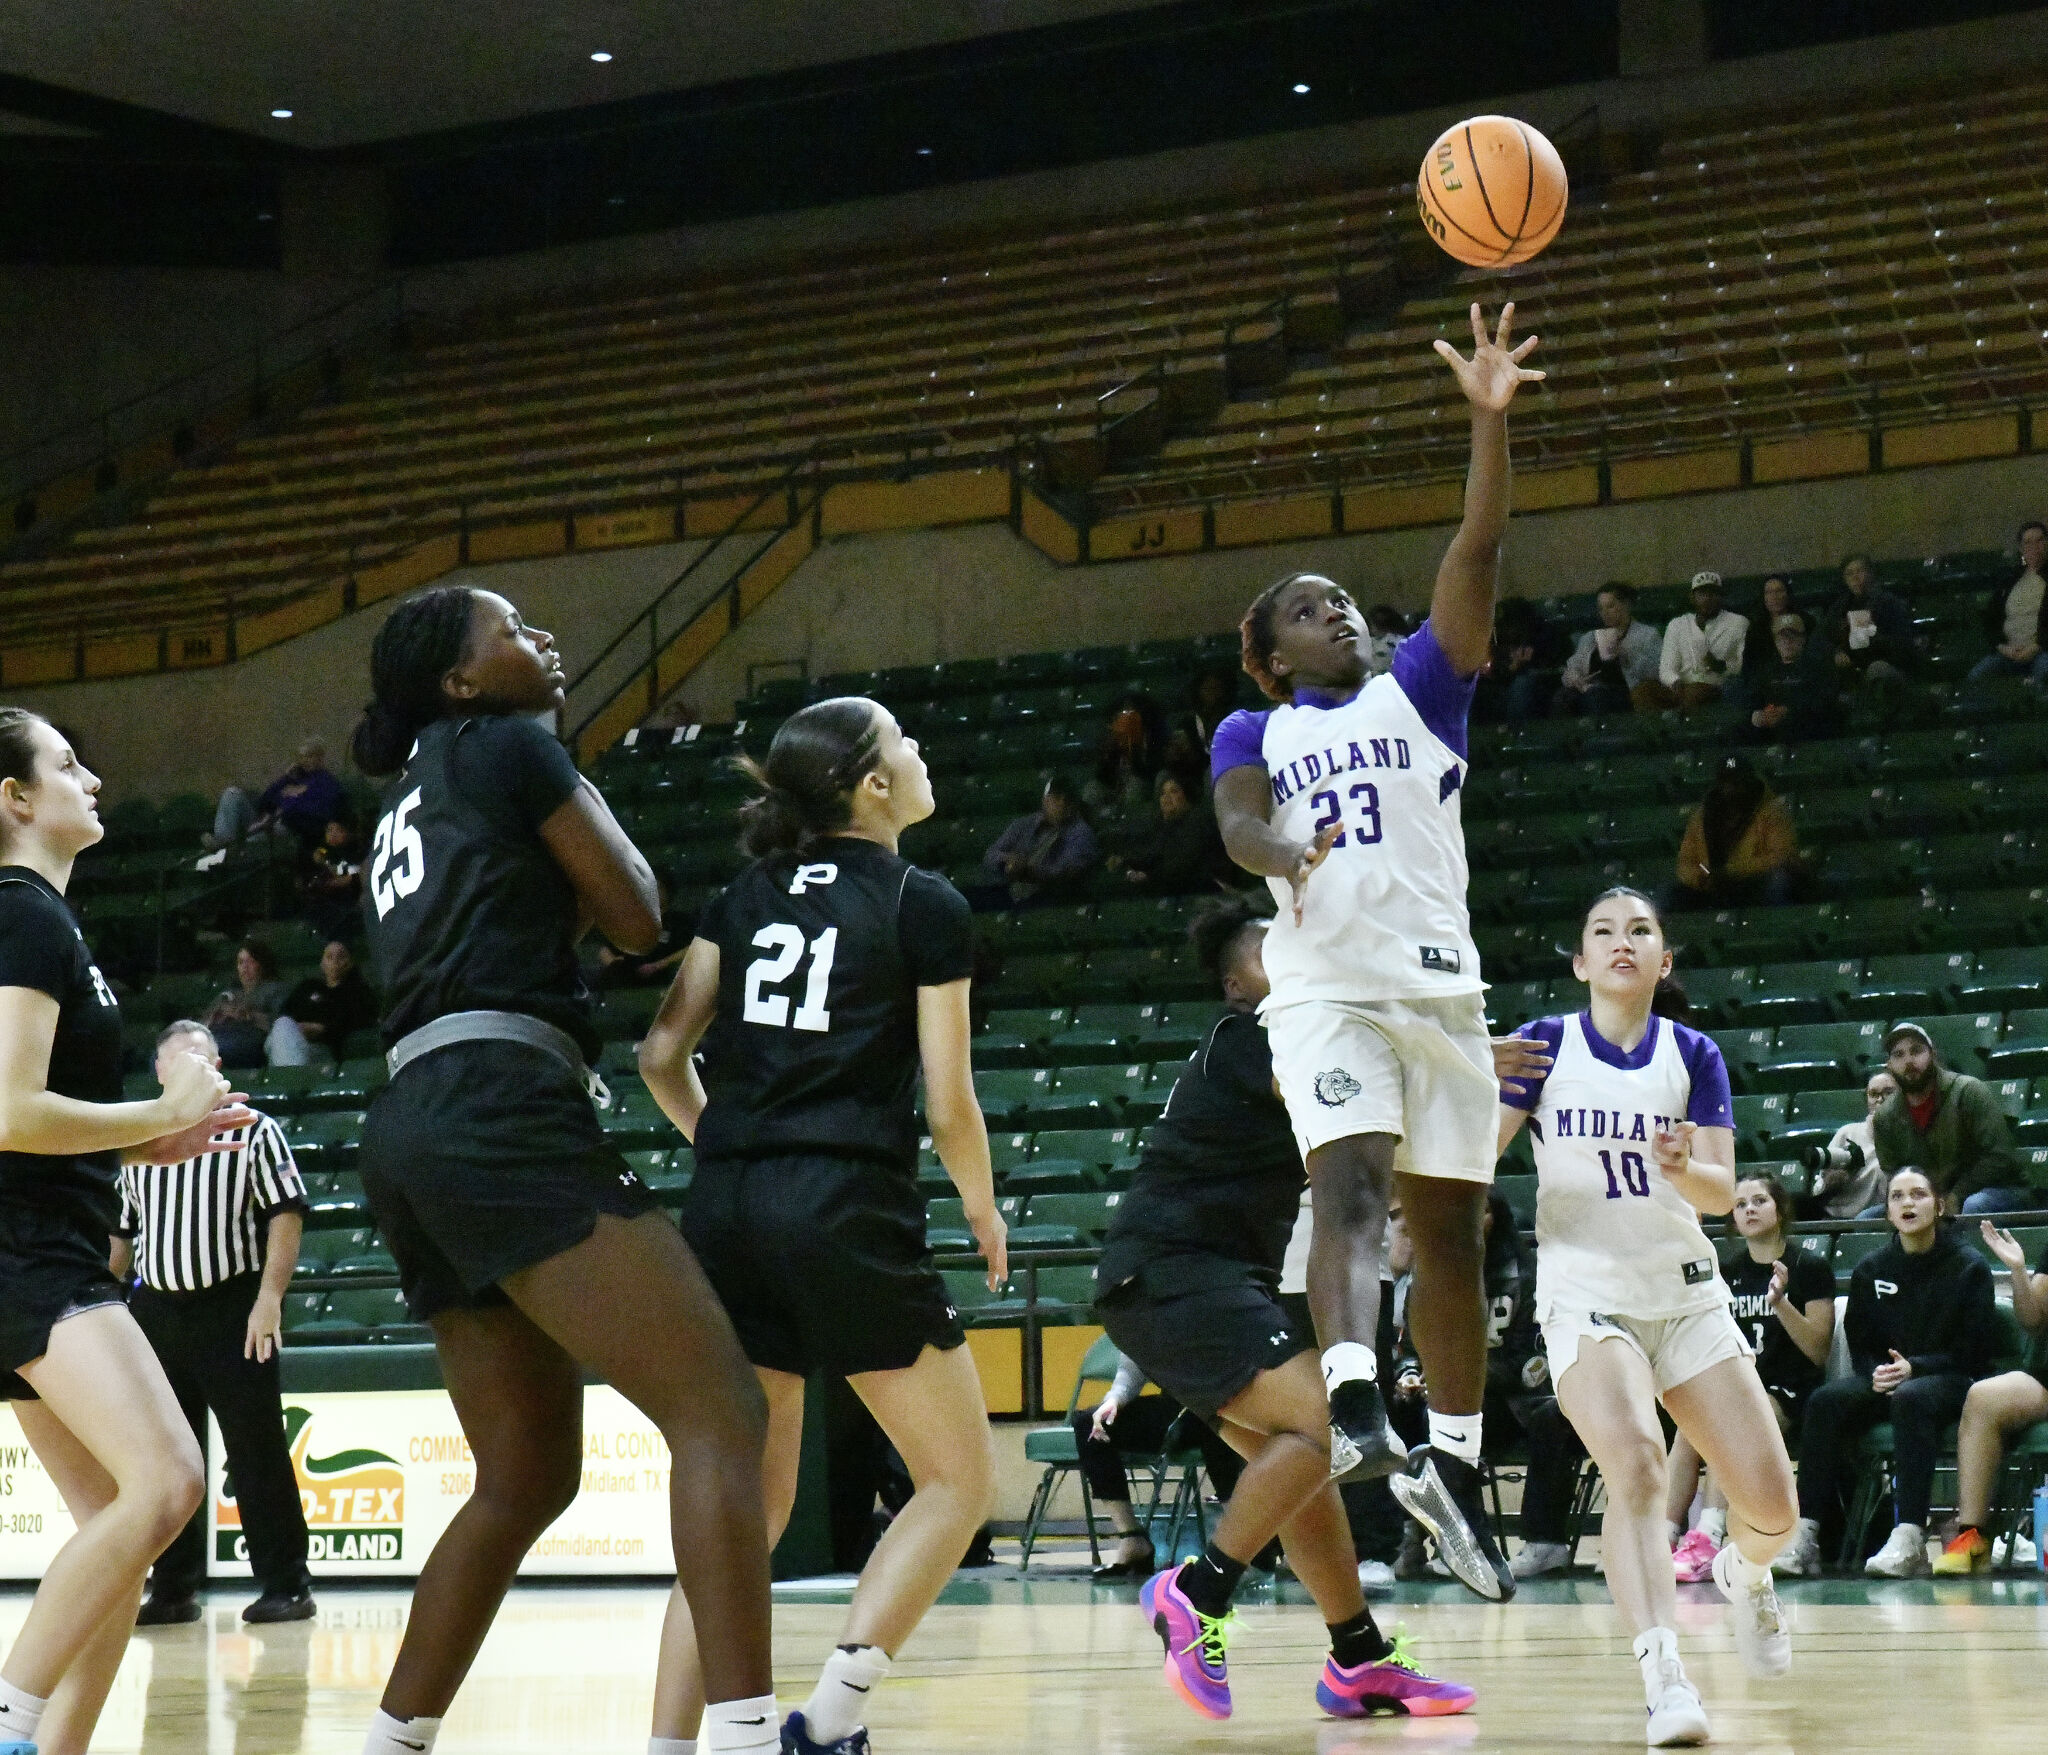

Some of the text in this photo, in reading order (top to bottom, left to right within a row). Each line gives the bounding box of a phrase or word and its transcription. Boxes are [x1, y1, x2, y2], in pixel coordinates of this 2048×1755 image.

[1271, 738, 1412, 807] MIDLAND
[1310, 782, 1383, 848] 23
[370, 784, 425, 923] 25
[788, 863, 838, 894] P
[743, 922, 838, 1032] 21
[1598, 1149, 1651, 1199] 10
[1874, 1279, 1899, 1300] P
[1752, 1322, 1765, 1355] 3
[0, 1447, 41, 1470] WY.,
[408, 1436, 472, 1463] COMME
[0, 1474, 13, 1496] S
[440, 1472, 472, 1496] 5206
[644, 1469, 662, 1493] TX
[301, 1487, 402, 1522] O-TEX
[307, 1533, 399, 1561] DLAND
